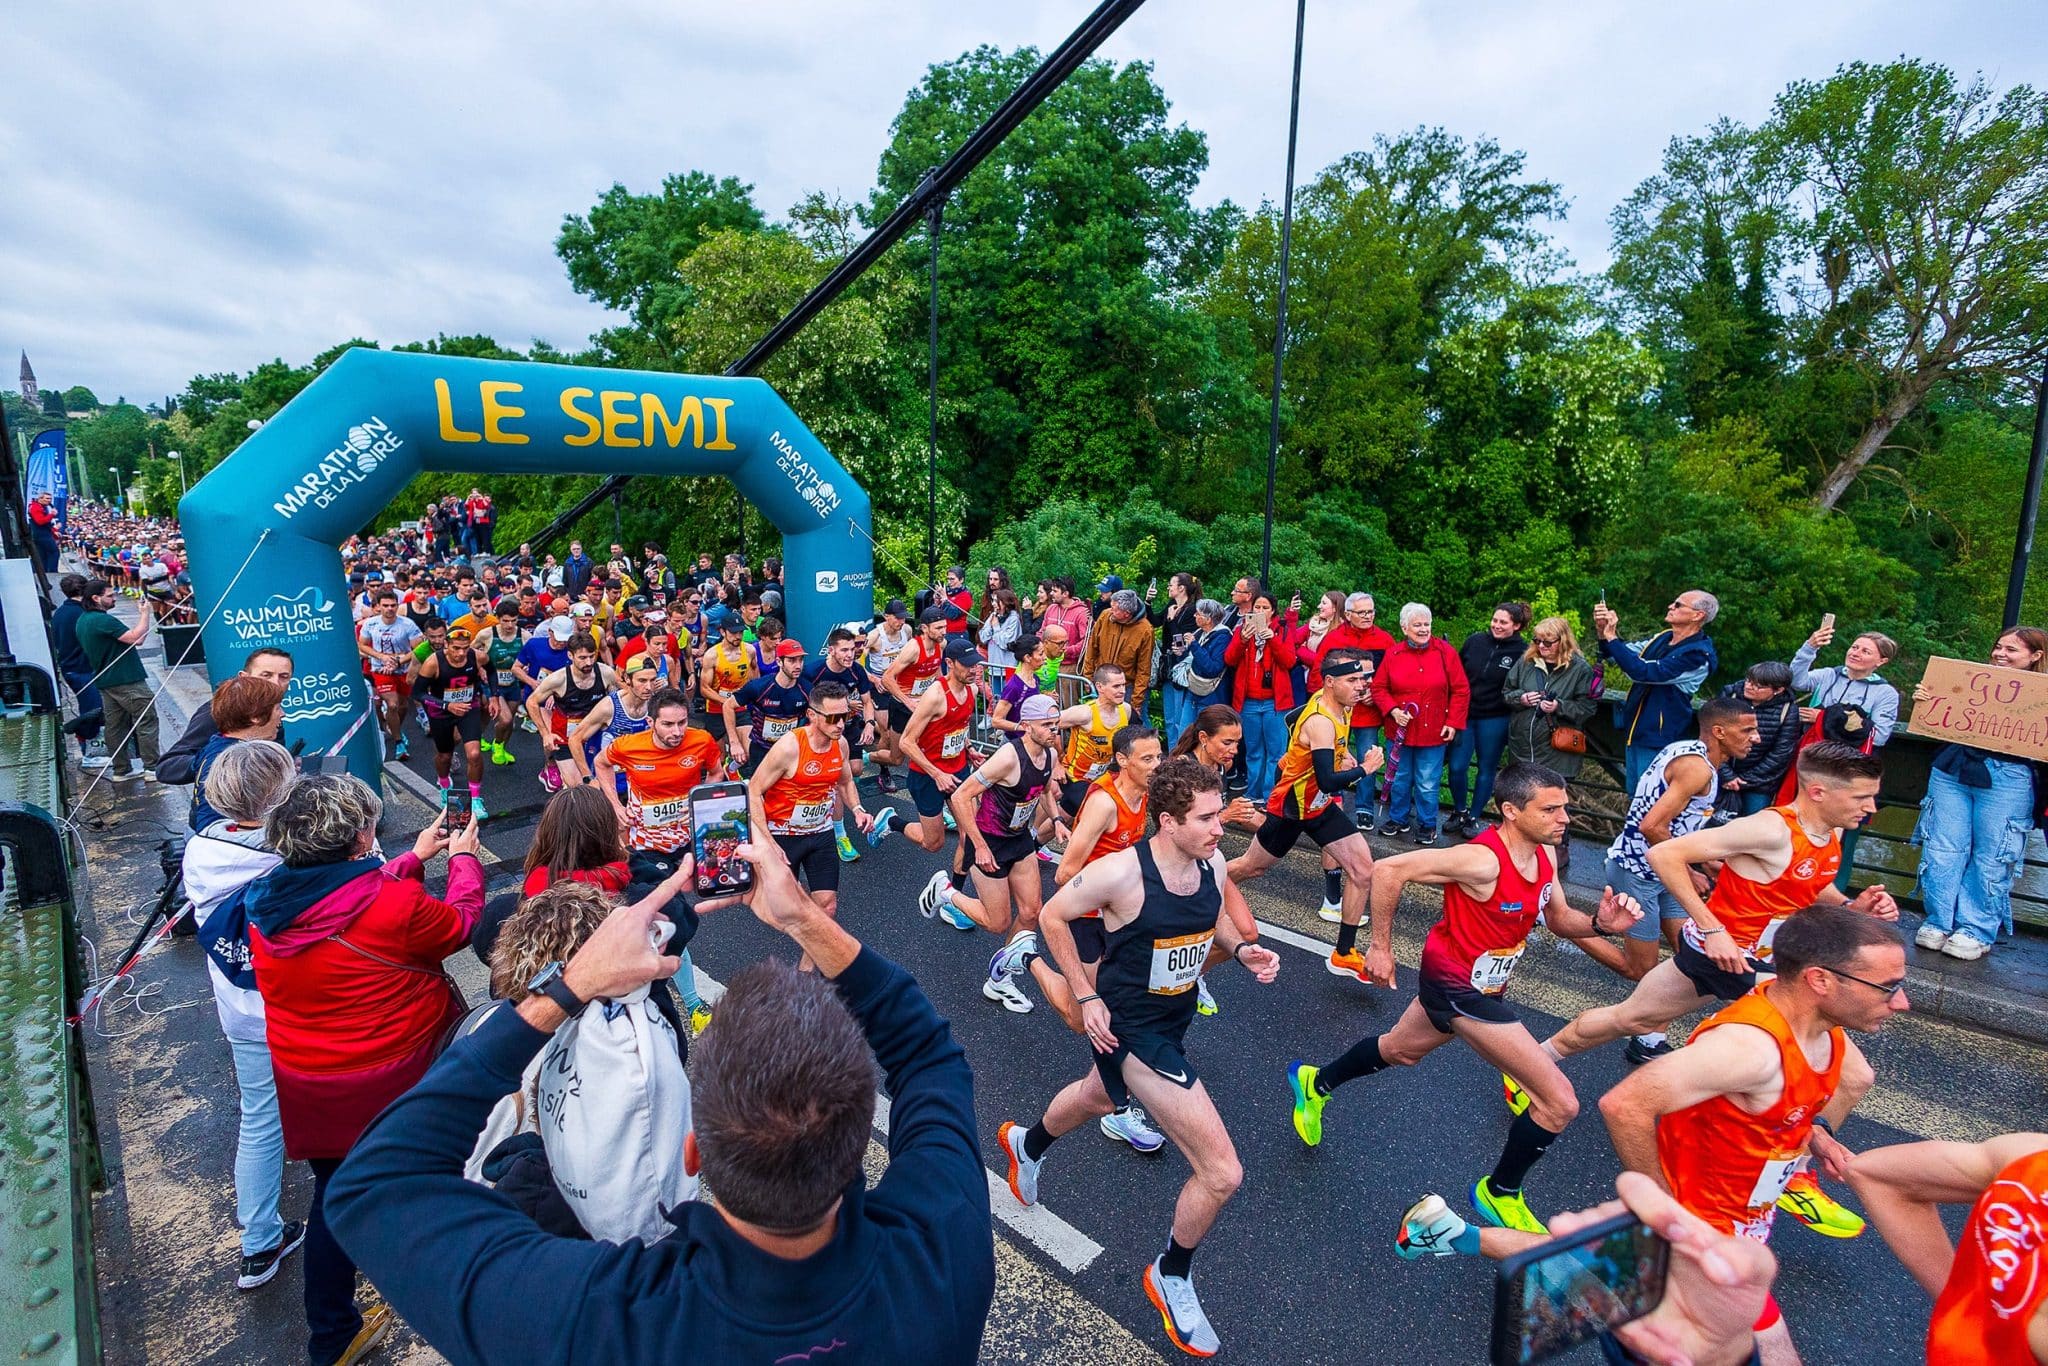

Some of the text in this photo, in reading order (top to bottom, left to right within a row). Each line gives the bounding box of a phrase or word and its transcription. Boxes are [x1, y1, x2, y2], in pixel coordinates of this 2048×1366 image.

[434, 378, 737, 450] LE SEMI
[273, 415, 388, 519] MARATHON
[314, 431, 404, 509] DE LA LOIRE
[769, 430, 842, 510] MARATHON
[776, 456, 833, 520] DE LA LOIRE
[223, 603, 313, 625] SAUMUR
[235, 616, 334, 640] VAL DE LOIRE
[287, 673, 329, 691] nes
[1968, 672, 2024, 706] GO
[653, 801, 683, 818] 9405
[801, 803, 827, 818] 9406
[1167, 943, 1206, 972] 6006
